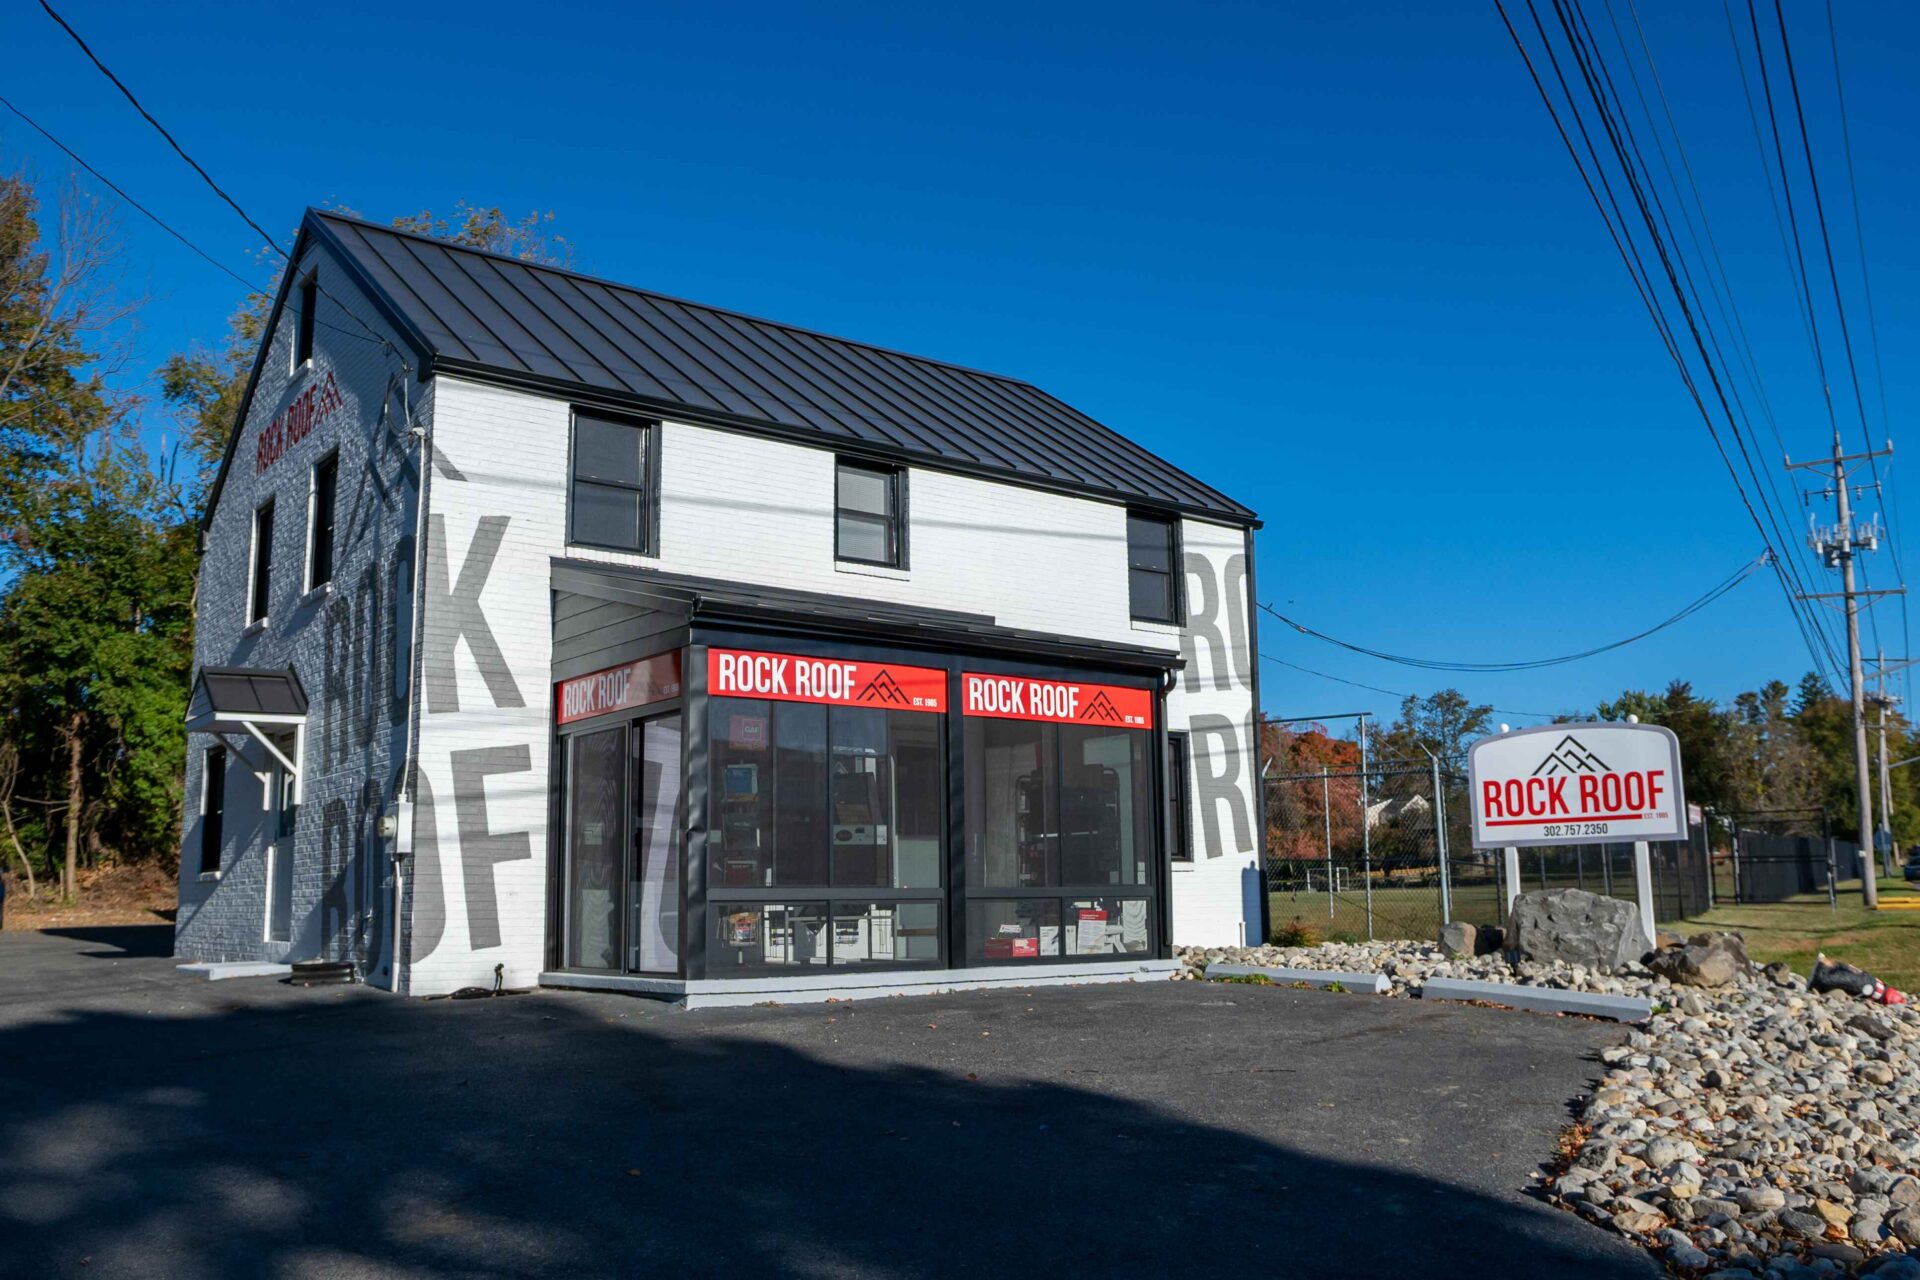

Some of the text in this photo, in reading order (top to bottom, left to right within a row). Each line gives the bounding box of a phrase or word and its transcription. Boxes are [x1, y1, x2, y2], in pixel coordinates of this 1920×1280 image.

[256, 384, 317, 476] ROCK ROOF
[563, 668, 632, 718] ROCK ROOF
[719, 654, 788, 695] ROCK
[795, 660, 857, 700] ROOF
[969, 677, 1025, 714] ROCK
[1029, 683, 1079, 718] ROOF
[1483, 770, 1664, 818] ROCK ROOF
[1543, 823, 1609, 837] 302.757.2350
